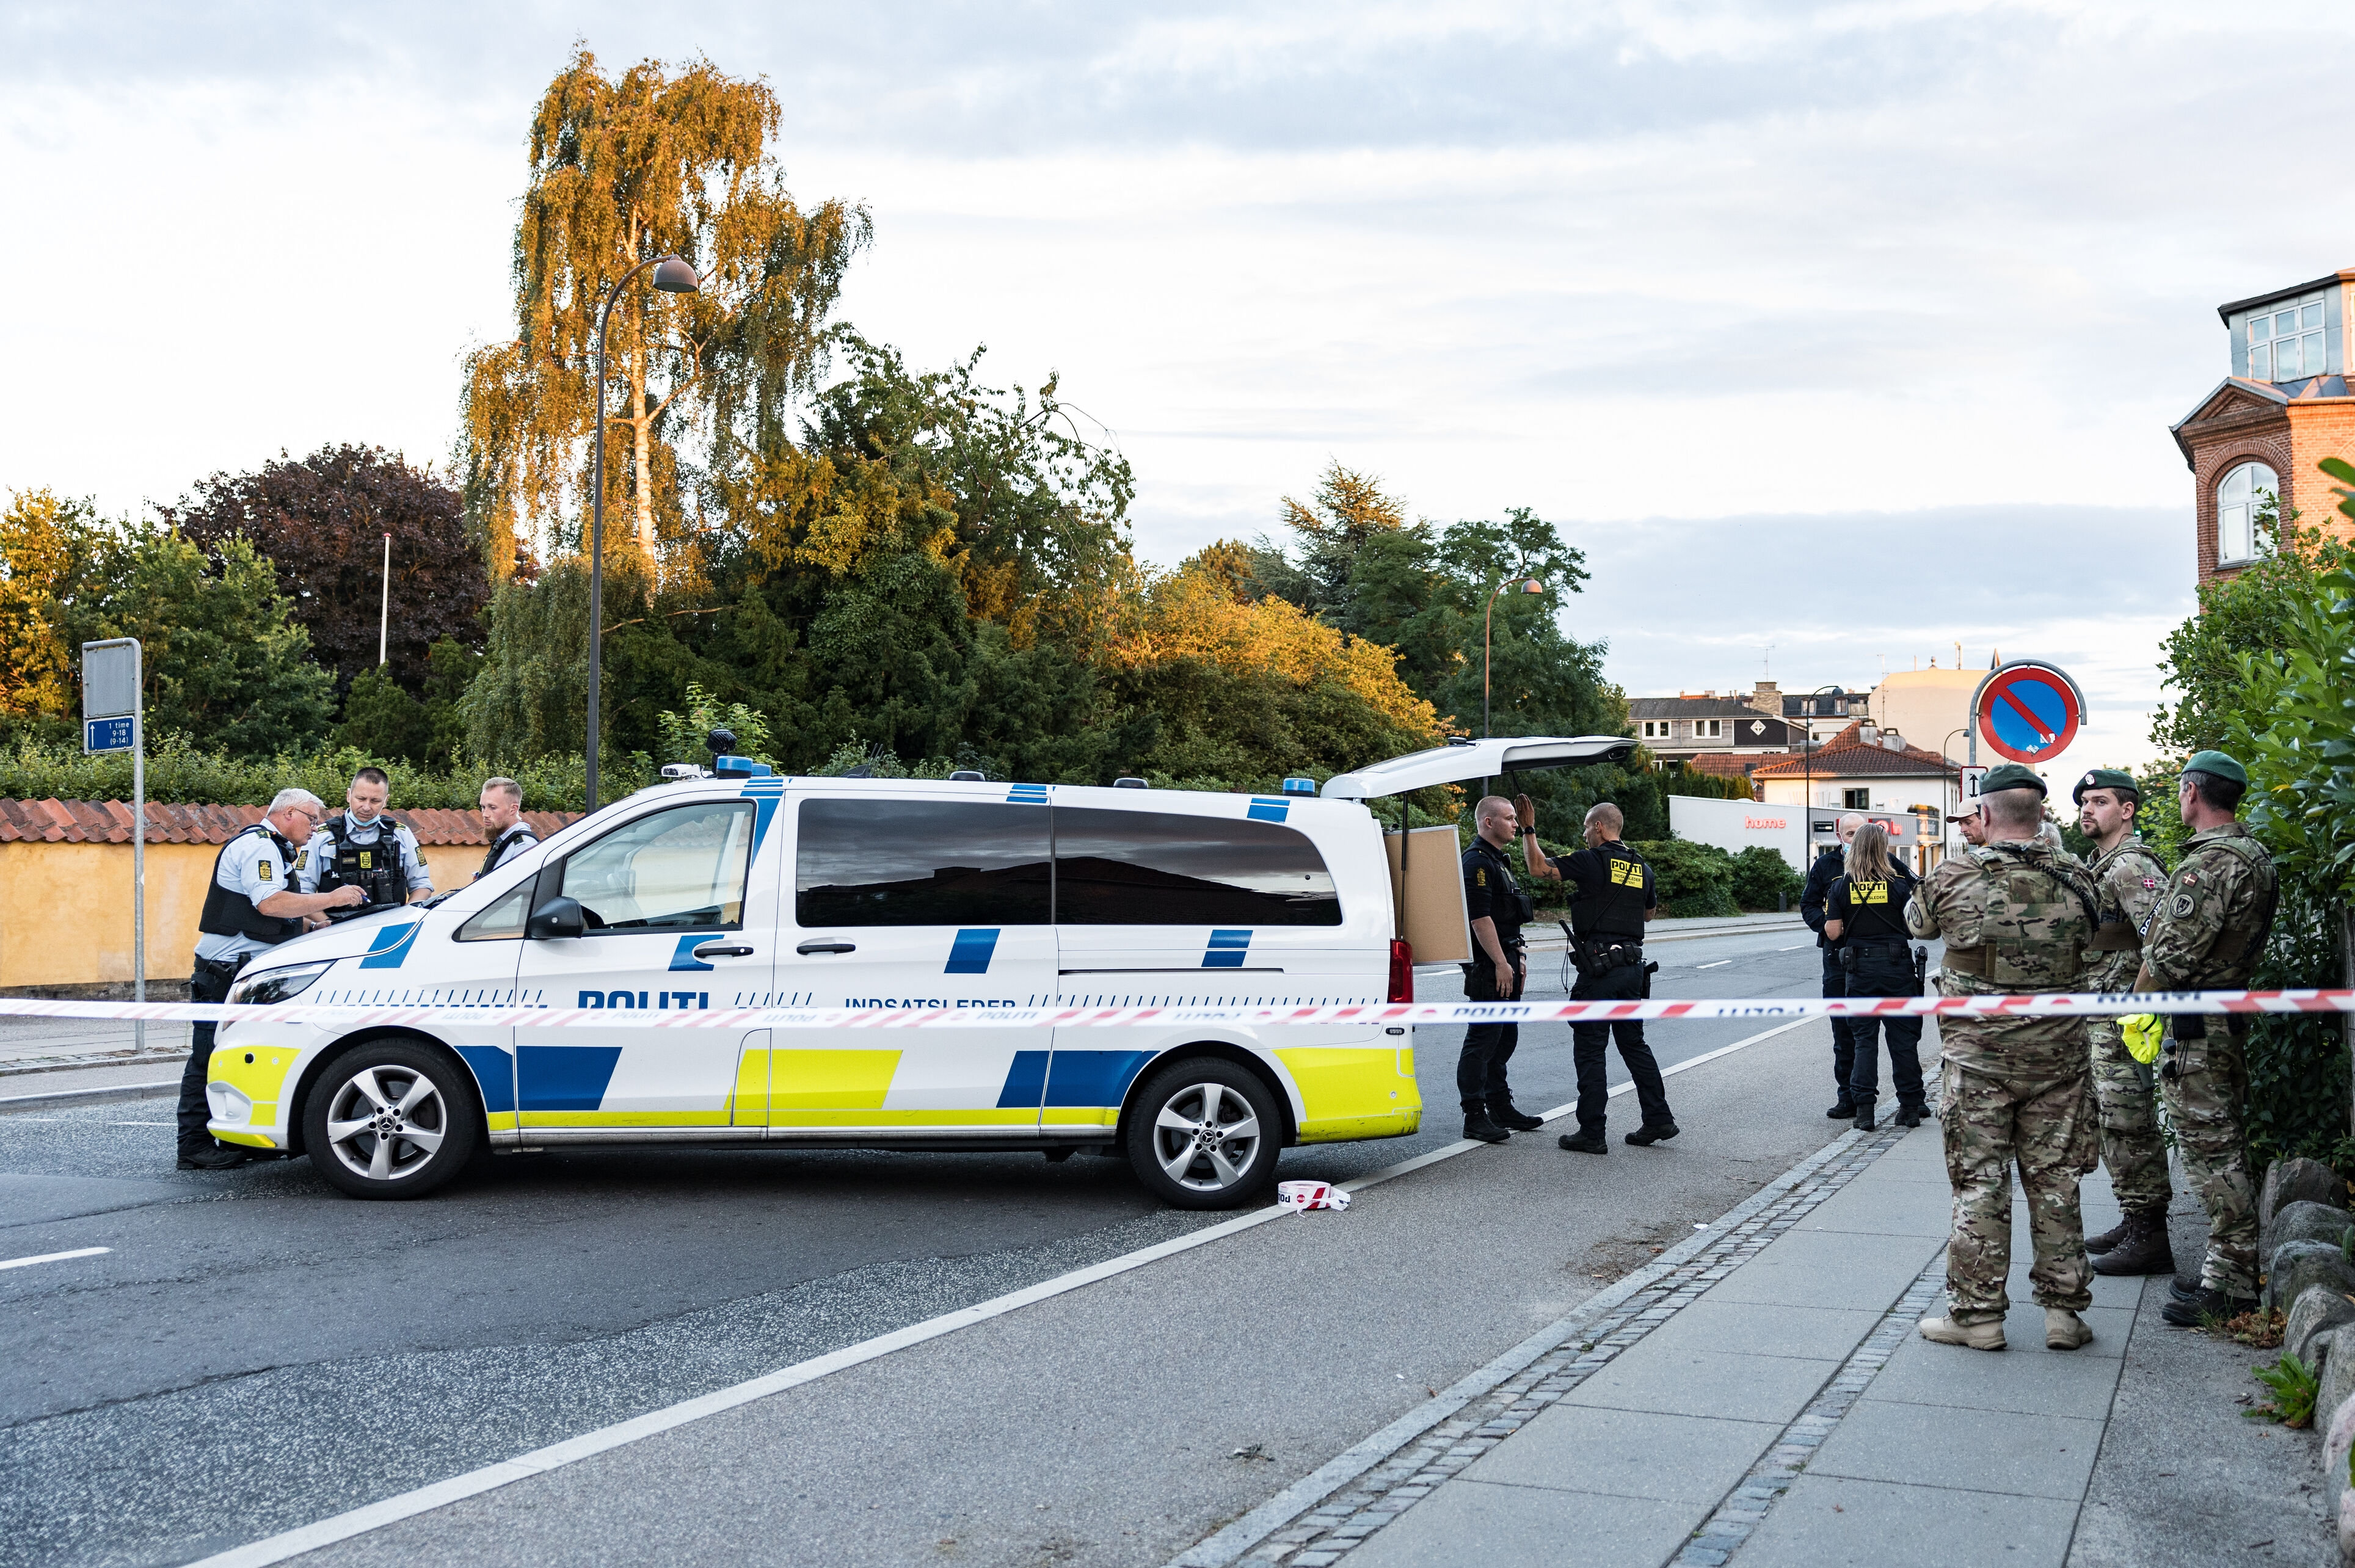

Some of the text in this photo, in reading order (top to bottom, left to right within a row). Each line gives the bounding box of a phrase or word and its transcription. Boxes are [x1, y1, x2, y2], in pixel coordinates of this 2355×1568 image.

[110, 736, 129, 746] (9-14)
[1745, 815, 1786, 829] home
[1614, 873, 1641, 882] INDSALEDER
[977, 1011, 1038, 1020] POLITI
[1454, 1007, 1531, 1017] POLITI
